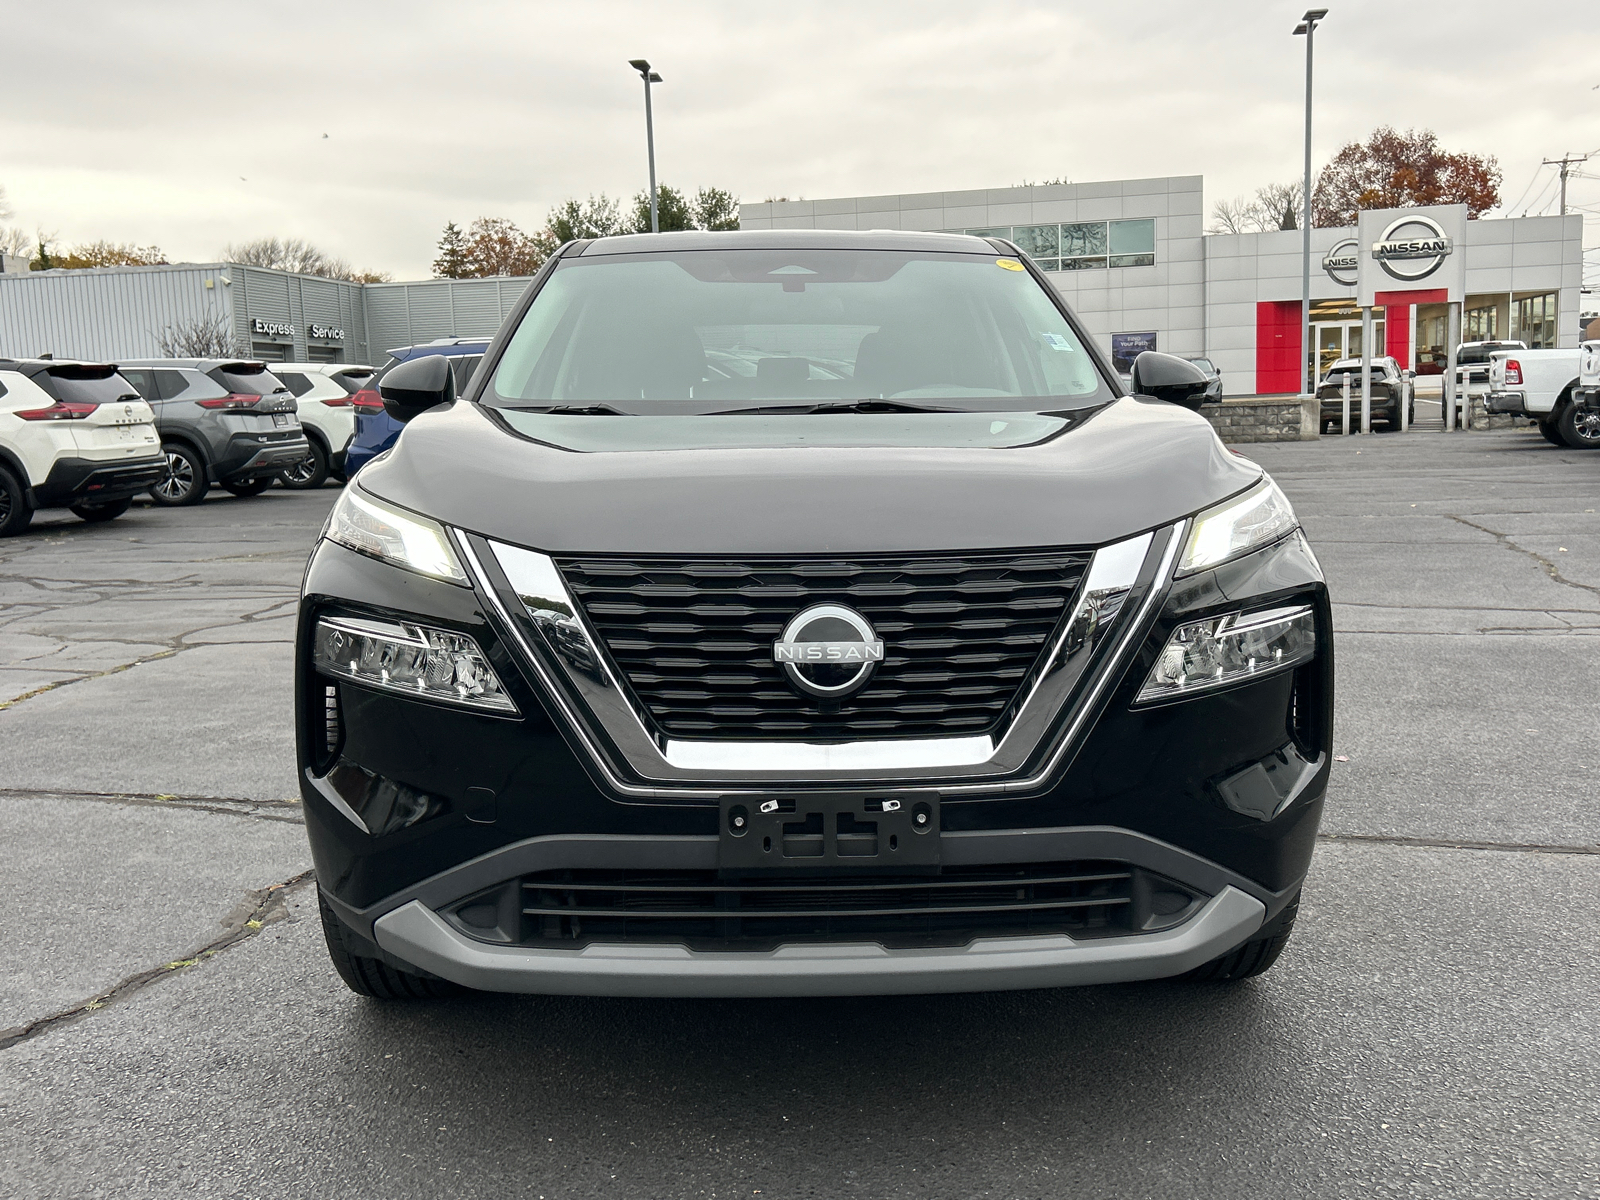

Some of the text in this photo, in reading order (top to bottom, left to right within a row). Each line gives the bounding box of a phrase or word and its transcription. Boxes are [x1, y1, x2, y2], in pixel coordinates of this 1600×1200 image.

[1380, 241, 1445, 255] NISSAN
[1328, 257, 1358, 267] NISS
[256, 319, 345, 339] Express Service
[778, 645, 880, 659] NISSAN
